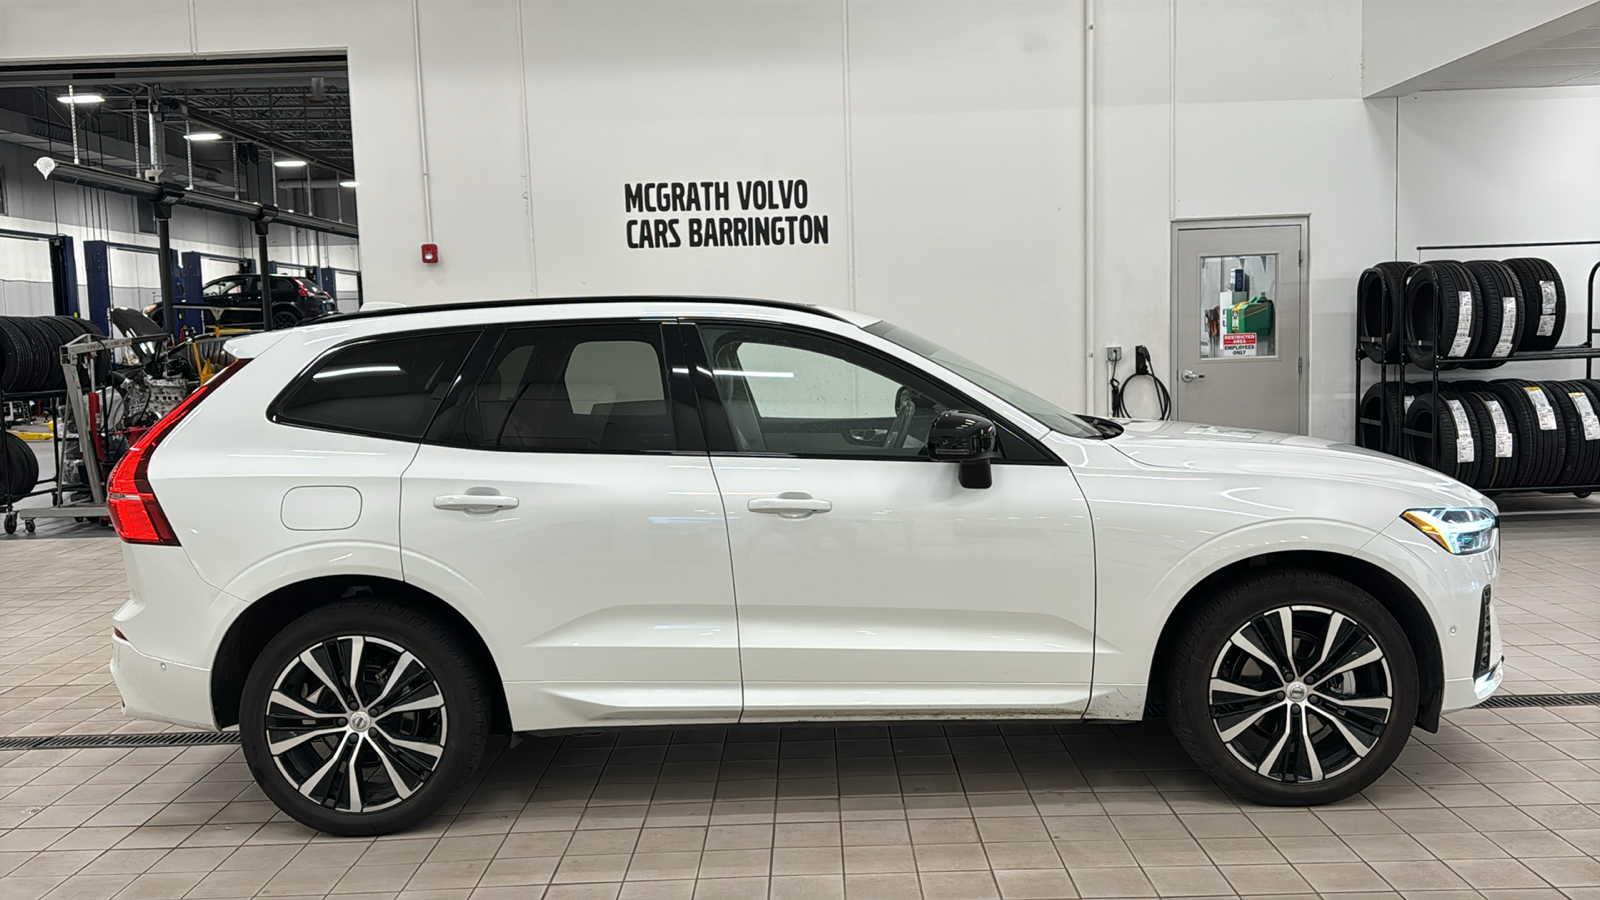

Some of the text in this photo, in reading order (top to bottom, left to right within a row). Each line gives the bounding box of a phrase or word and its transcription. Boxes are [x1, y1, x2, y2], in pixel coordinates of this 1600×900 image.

[624, 179, 808, 213] MCGRATH VOLVO
[626, 214, 829, 248] CARS BARRINGTON
